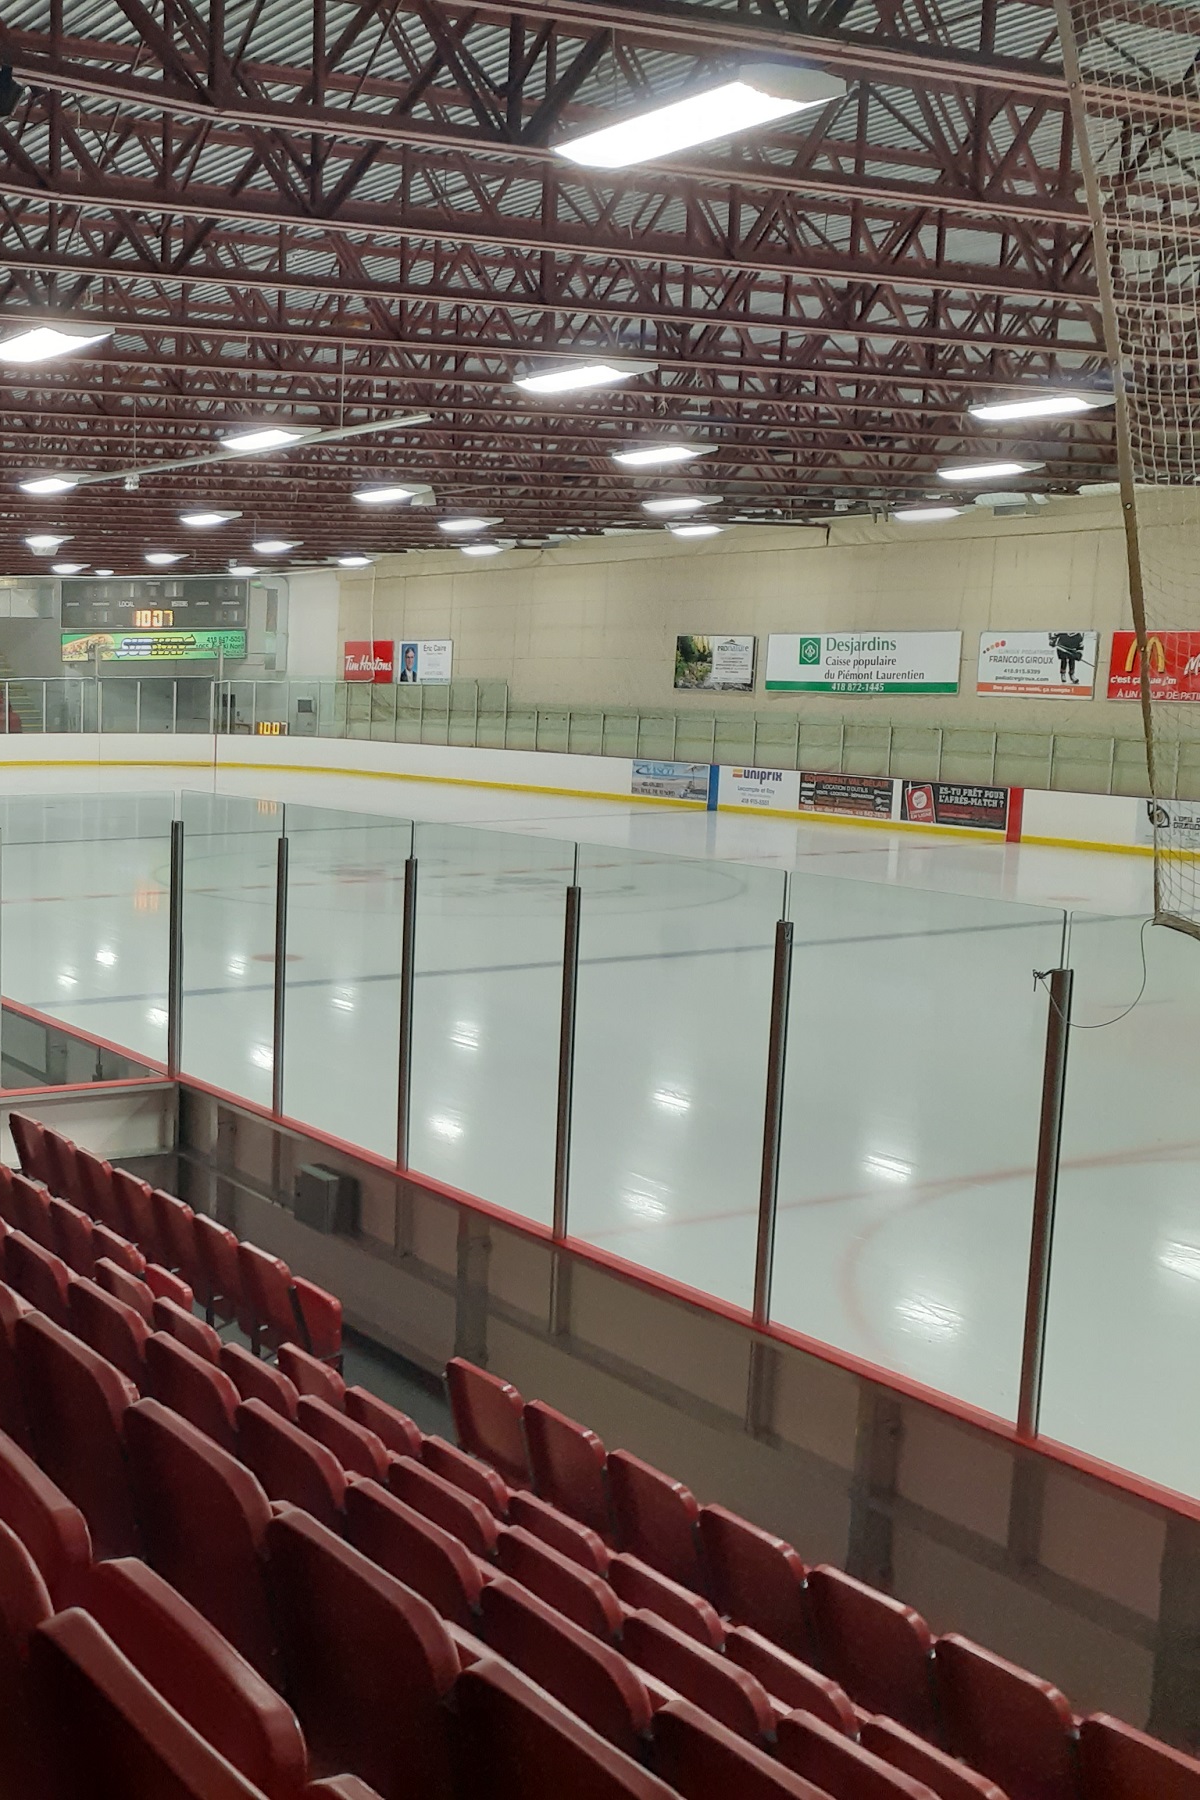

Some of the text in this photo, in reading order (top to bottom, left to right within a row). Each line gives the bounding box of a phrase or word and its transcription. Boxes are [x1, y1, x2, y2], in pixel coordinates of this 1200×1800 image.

[118, 600, 135, 608] LOCAL
[115, 634, 197, 659] SUBWAY
[434, 644, 447, 652] Caire
[826, 637, 897, 655] Desjardins
[345, 654, 392, 671] Tim Hortons
[825, 656, 897, 668] Caisse populaire
[1025, 656, 1054, 665] GIROUX
[824, 670, 925, 680] du Piémont Laurentien
[1110, 675, 1131, 684] c'est
[831, 683, 885, 692] 418 872-1445
[1116, 688, 1124, 698] À
[1125, 690, 1138, 698] UN
[1166, 691, 1179, 699] DE
[939, 786, 961, 796] ES-TU
[984, 790, 1005, 800] POUR
[999, 800, 1004, 808] ?
